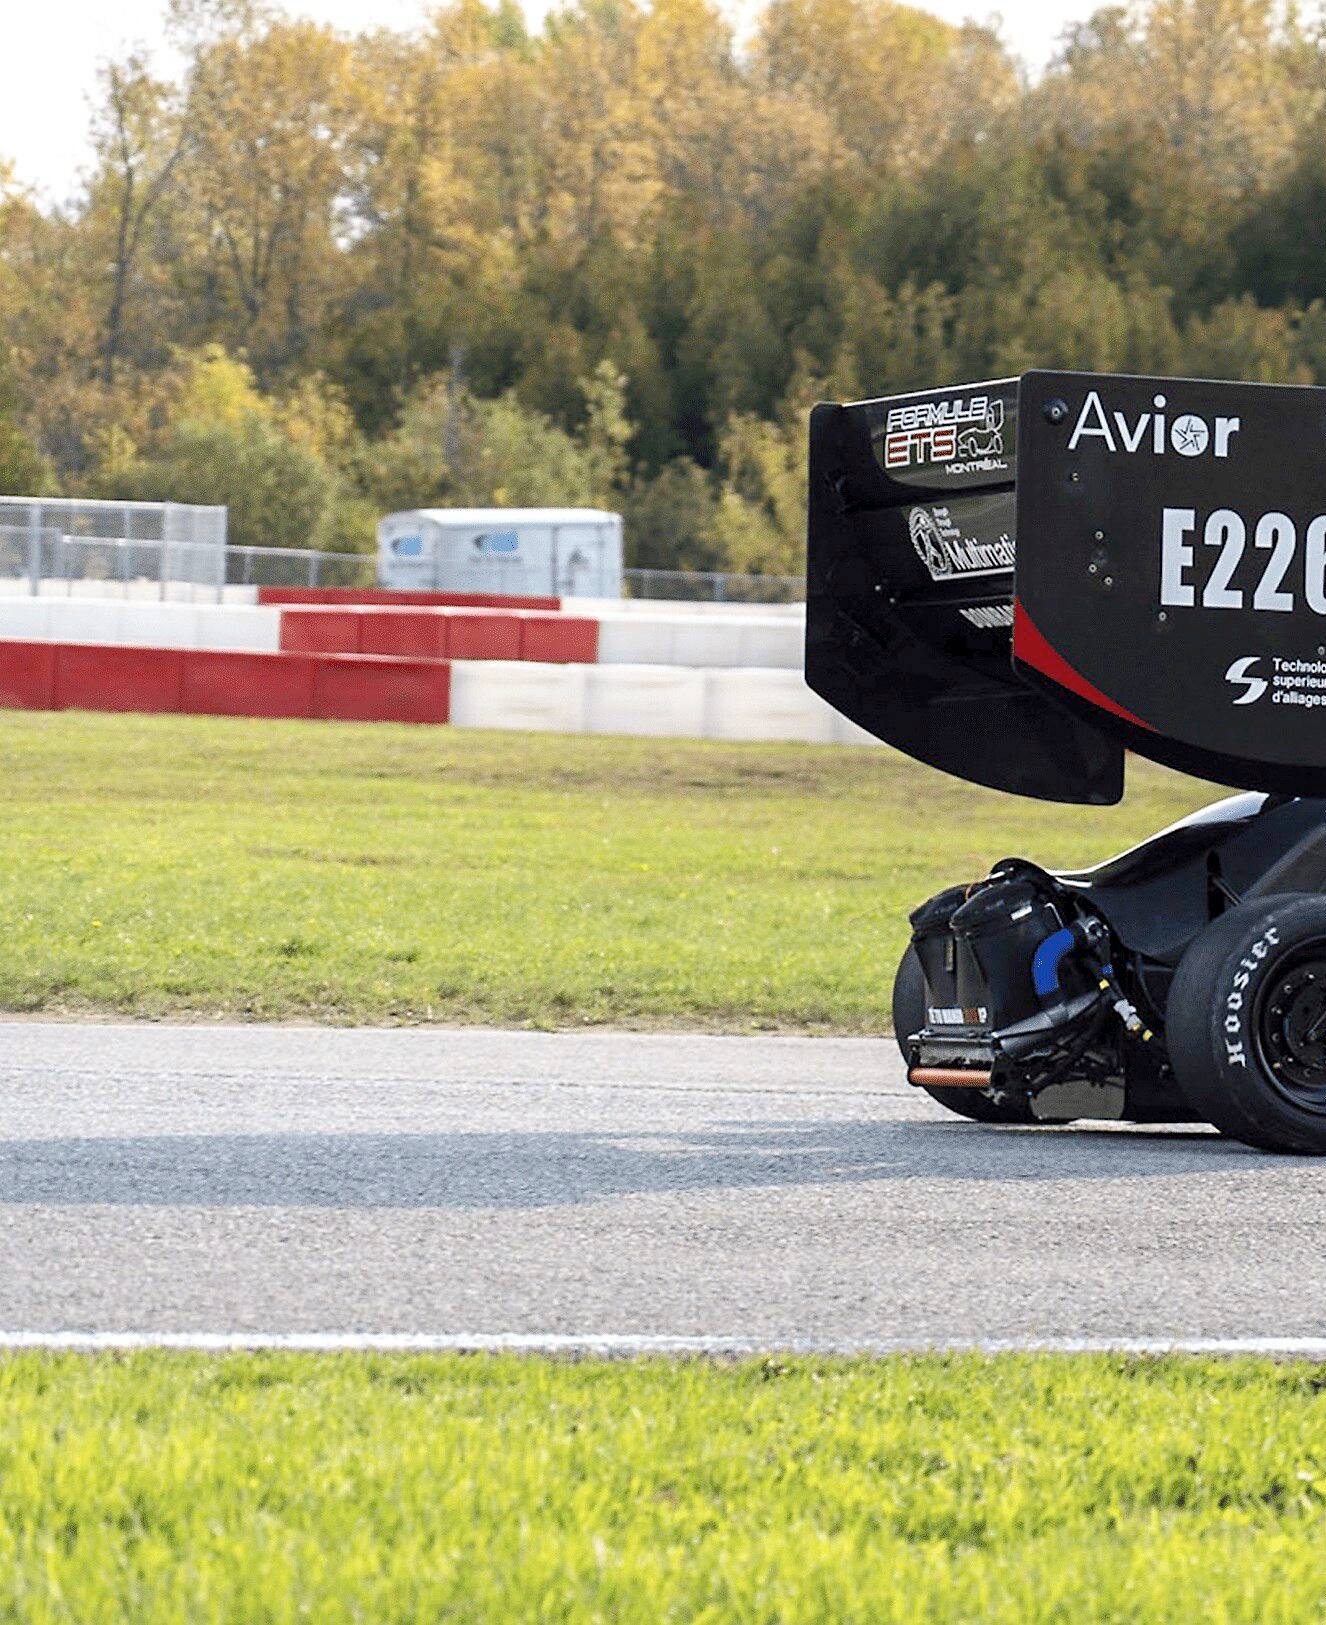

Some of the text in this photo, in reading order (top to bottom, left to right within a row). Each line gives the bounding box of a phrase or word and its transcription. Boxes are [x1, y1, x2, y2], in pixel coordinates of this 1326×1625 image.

[886, 396, 988, 432] FORMULE
[1068, 391, 1240, 458] Avior
[884, 425, 957, 468] ETS
